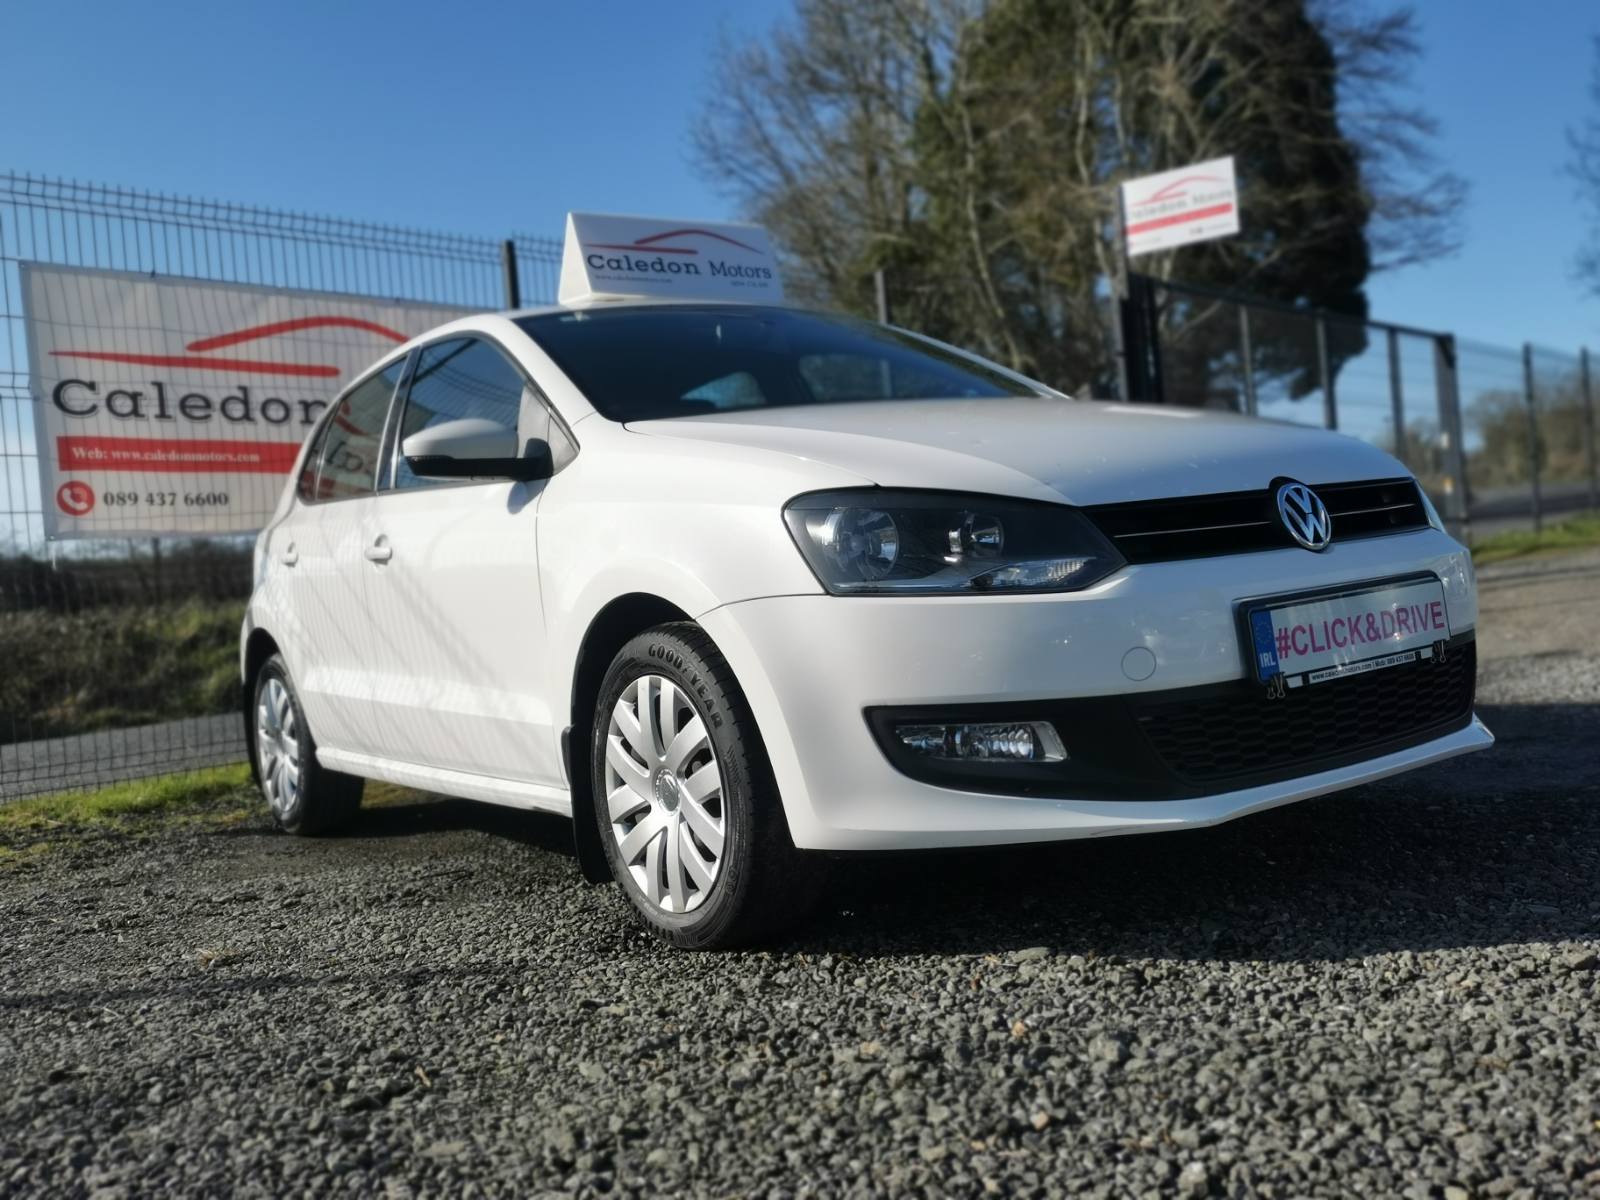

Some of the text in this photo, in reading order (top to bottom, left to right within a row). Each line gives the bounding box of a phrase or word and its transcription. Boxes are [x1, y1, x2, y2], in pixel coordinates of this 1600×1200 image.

[587, 254, 772, 280] Caledon Motors
[72, 446, 260, 464] Web: www.caledonmotors.com
[102, 491, 229, 507] 089 437 6600
[1276, 601, 1445, 660] #CLICK&DRIVE
[1258, 652, 1276, 667] IRL
